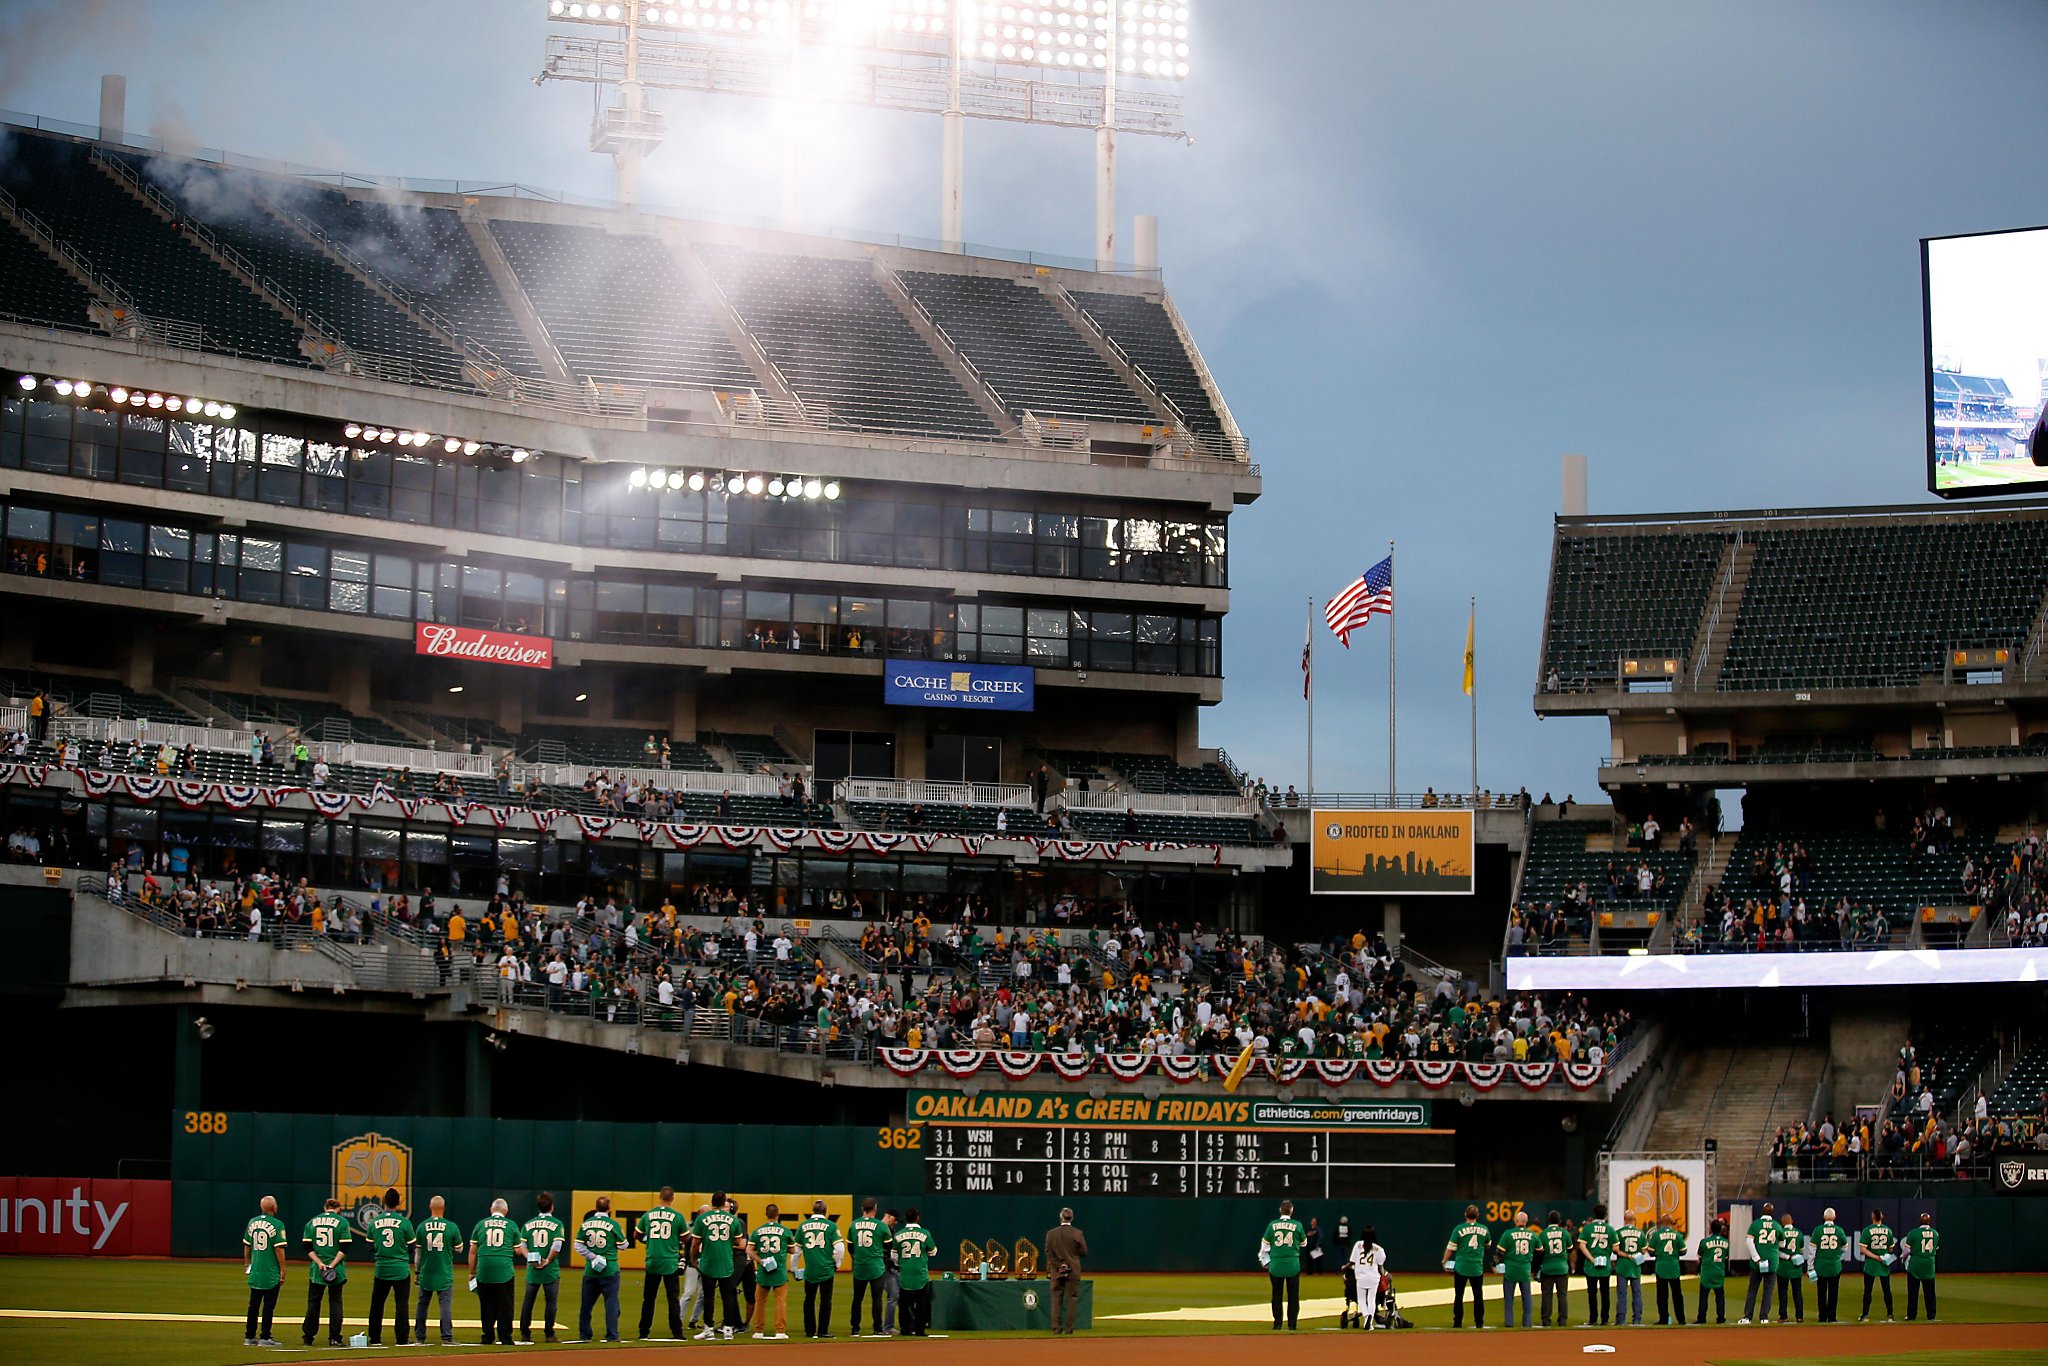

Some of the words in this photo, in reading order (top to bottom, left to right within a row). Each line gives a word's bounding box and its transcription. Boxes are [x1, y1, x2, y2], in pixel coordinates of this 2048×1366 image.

[423, 626, 548, 664] Budweiser
[894, 675, 947, 690] CACHE
[972, 680, 1025, 693] CREEK
[924, 693, 957, 702] CASINO
[963, 695, 995, 703] RESORT
[1345, 825, 1389, 839] ROOTED
[1392, 825, 1405, 839] IN
[1408, 825, 1460, 839] OAKLAND
[915, 1095, 1033, 1118] OAKLAND
[1036, 1096, 1070, 1119] A's
[1075, 1099, 1151, 1121] GREEN
[1156, 1101, 1250, 1122] FRIDAYS
[1258, 1106, 1420, 1123] athletics.com/greenfridays
[184, 1111, 228, 1134] 388
[878, 1127, 921, 1149] 362
[967, 1130, 993, 1143] WSH
[1046, 1131, 1053, 1144] 2
[1017, 1138, 1023, 1150] F
[1105, 1132, 1127, 1145] PHI
[1180, 1134, 1187, 1146] 4
[1236, 1135, 1260, 1147] MIL
[1312, 1135, 1317, 1148] 1
[967, 1144, 992, 1157] CIN
[1046, 1146, 1053, 1158] 0
[1104, 1147, 1128, 1160] ATL
[1181, 1148, 1187, 1161] 3
[1152, 1140, 1158, 1153] 8
[1284, 1142, 1290, 1155] 1
[1236, 1149, 1260, 1162] S.D.
[1311, 1150, 1318, 1162] 0
[345, 1151, 399, 1187] 50
[967, 1163, 992, 1175] CHI
[1046, 1164, 1051, 1176] 1
[1102, 1165, 1128, 1178] COL
[1180, 1166, 1186, 1178] 0
[1238, 1167, 1261, 1179] S.F.
[966, 1177, 993, 1191] MIA
[1046, 1179, 1051, 1191] 1
[1104, 1180, 1127, 1192] ARI
[1180, 1181, 1187, 1193] 5
[1152, 1173, 1158, 1185] 2
[1284, 1174, 1290, 1187] 1
[1236, 1181, 1260, 1193] L.A.
[1635, 1181, 1680, 1213] 50
[0, 1186, 129, 1250] inity
[1486, 1201, 1525, 1223] 367
[425, 1222, 447, 1232] ELLIS
[650, 1220, 672, 1240] 20
[707, 1224, 730, 1242] 33
[252, 1231, 268, 1251] 19
[316, 1228, 334, 1247] 51
[382, 1228, 394, 1248] 3
[426, 1232, 444, 1252] 14
[485, 1228, 504, 1247] 10
[532, 1229, 549, 1248] 10
[585, 1230, 607, 1249] 36
[804, 1232, 826, 1249] 34
[857, 1230, 874, 1248] 16
[1274, 1231, 1294, 1247] 34
[1468, 1235, 1479, 1249] 4
[1590, 1233, 1609, 1249] 75
[1758, 1229, 1777, 1244] 24
[1820, 1235, 1838, 1250] 26
[1871, 1235, 1888, 1250] 22
[760, 1236, 781, 1254] 33
[901, 1241, 921, 1258] 24
[1549, 1239, 1563, 1254] 13
[1624, 1237, 1638, 1252] 15
[1663, 1240, 1674, 1255] 4
[1921, 1238, 1934, 1253] 14
[1359, 1252, 1374, 1267] 24
[1713, 1248, 1723, 1262] 2
